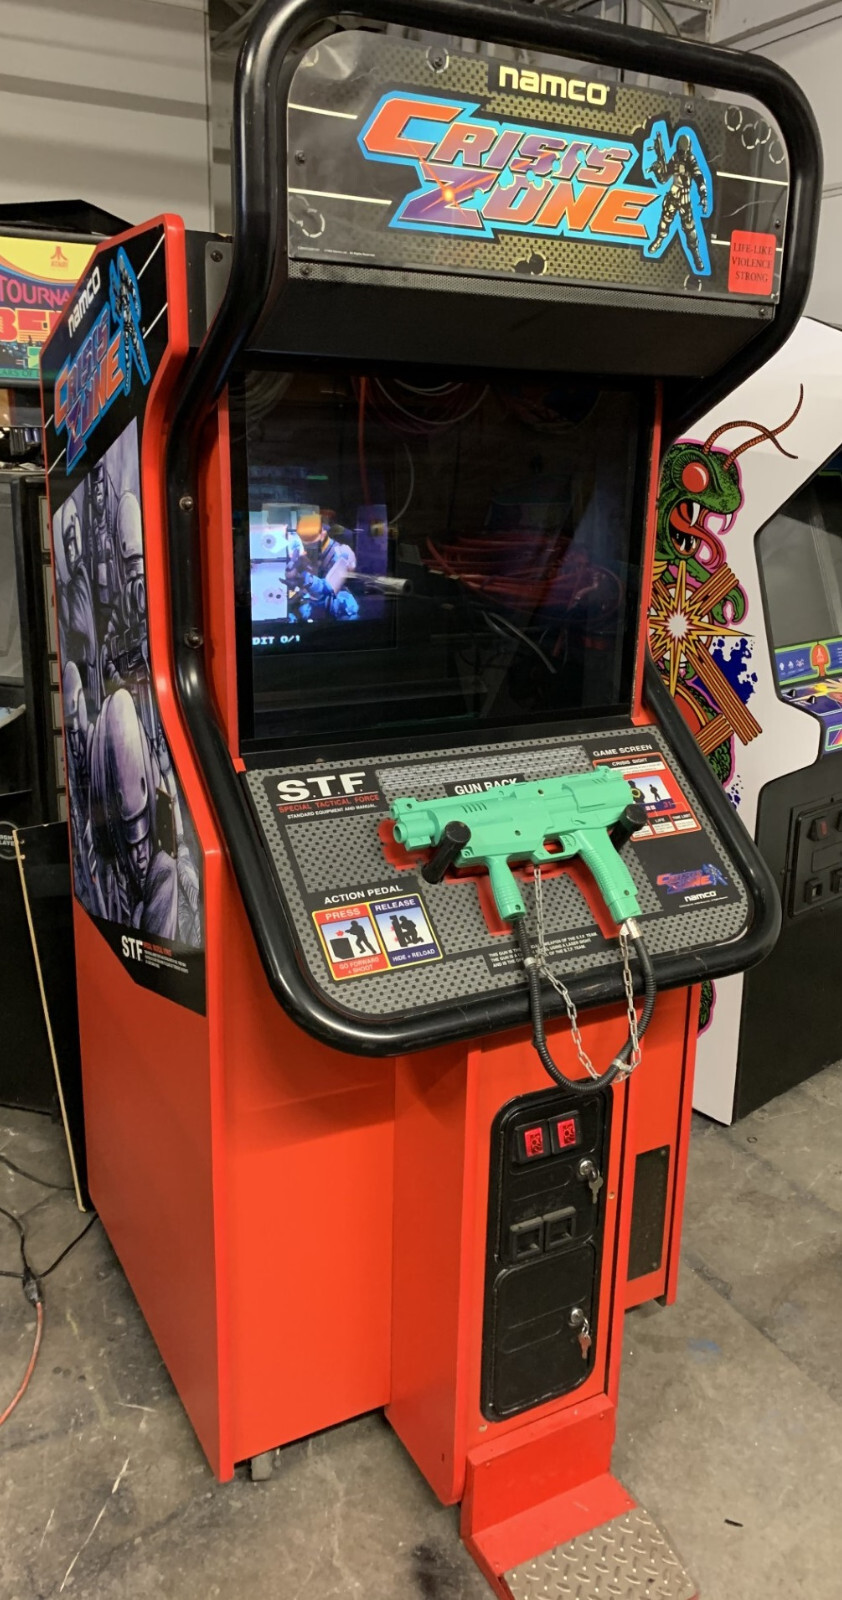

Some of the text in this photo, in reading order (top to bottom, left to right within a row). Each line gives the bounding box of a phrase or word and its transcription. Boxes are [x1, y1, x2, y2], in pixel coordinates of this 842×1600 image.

[498, 65, 607, 106] namco
[362, 97, 632, 185] CRISIS
[399, 161, 661, 238] ZONE
[733, 242, 774, 256] LIFE-LIKE
[731, 255, 772, 270] VIOLENCE
[735, 270, 769, 283] STRONG
[67, 265, 101, 338] namco
[593, 744, 653, 757] GAME SCREEN
[454, 782, 482, 795] GUN
[278, 793, 380, 814] SPECIAL TACTICAL FORCE
[287, 812, 315, 820] STANDARD
[315, 808, 344, 816] EQUIPMENT
[324, 884, 404, 905] ACTION PEDAL
[684, 890, 717, 903] namco
[374, 898, 416, 912] RELEASE
[325, 907, 361, 921] PRESS
[392, 954, 407, 962] HIDE
[411, 948, 436, 959] RELOAD
